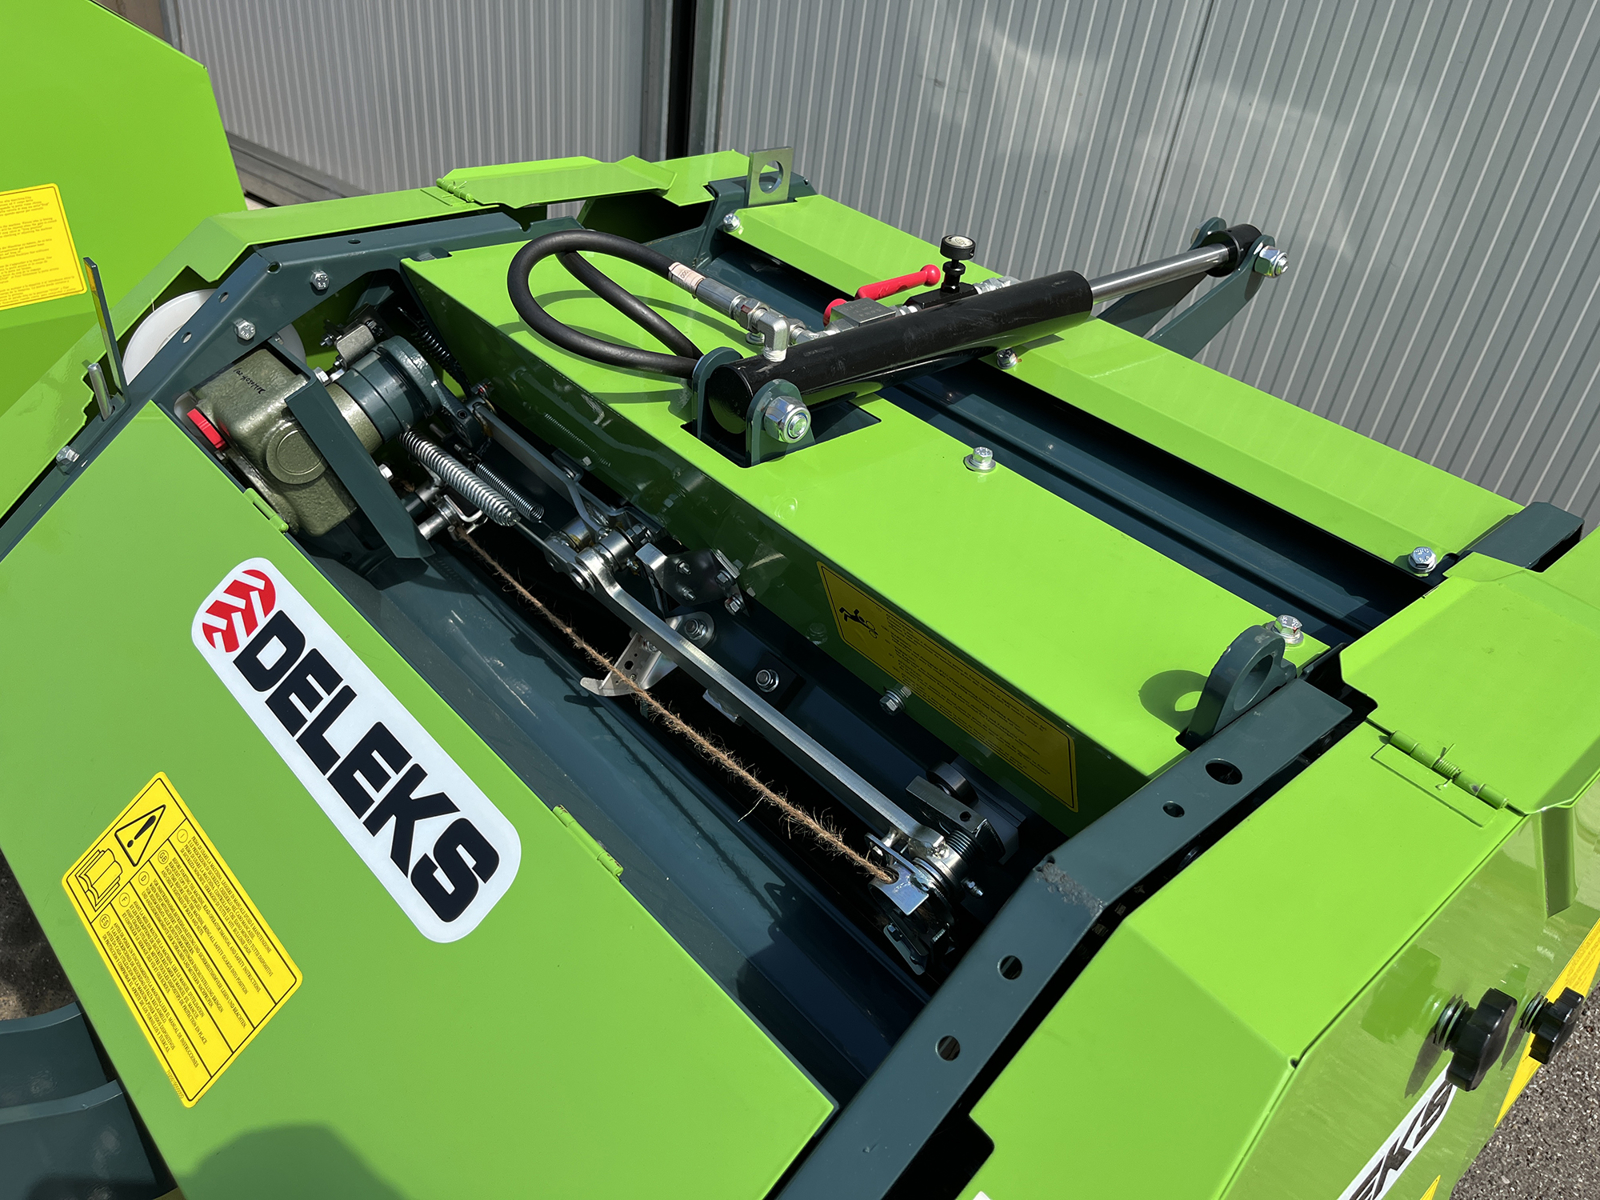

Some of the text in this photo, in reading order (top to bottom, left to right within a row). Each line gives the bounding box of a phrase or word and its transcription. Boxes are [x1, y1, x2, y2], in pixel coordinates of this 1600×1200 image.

[233, 610, 500, 923] DELEKS
[158, 850, 167, 863] GB
[140, 874, 147, 882] D
[121, 895, 127, 904] F
[100, 915, 109, 927] ES
